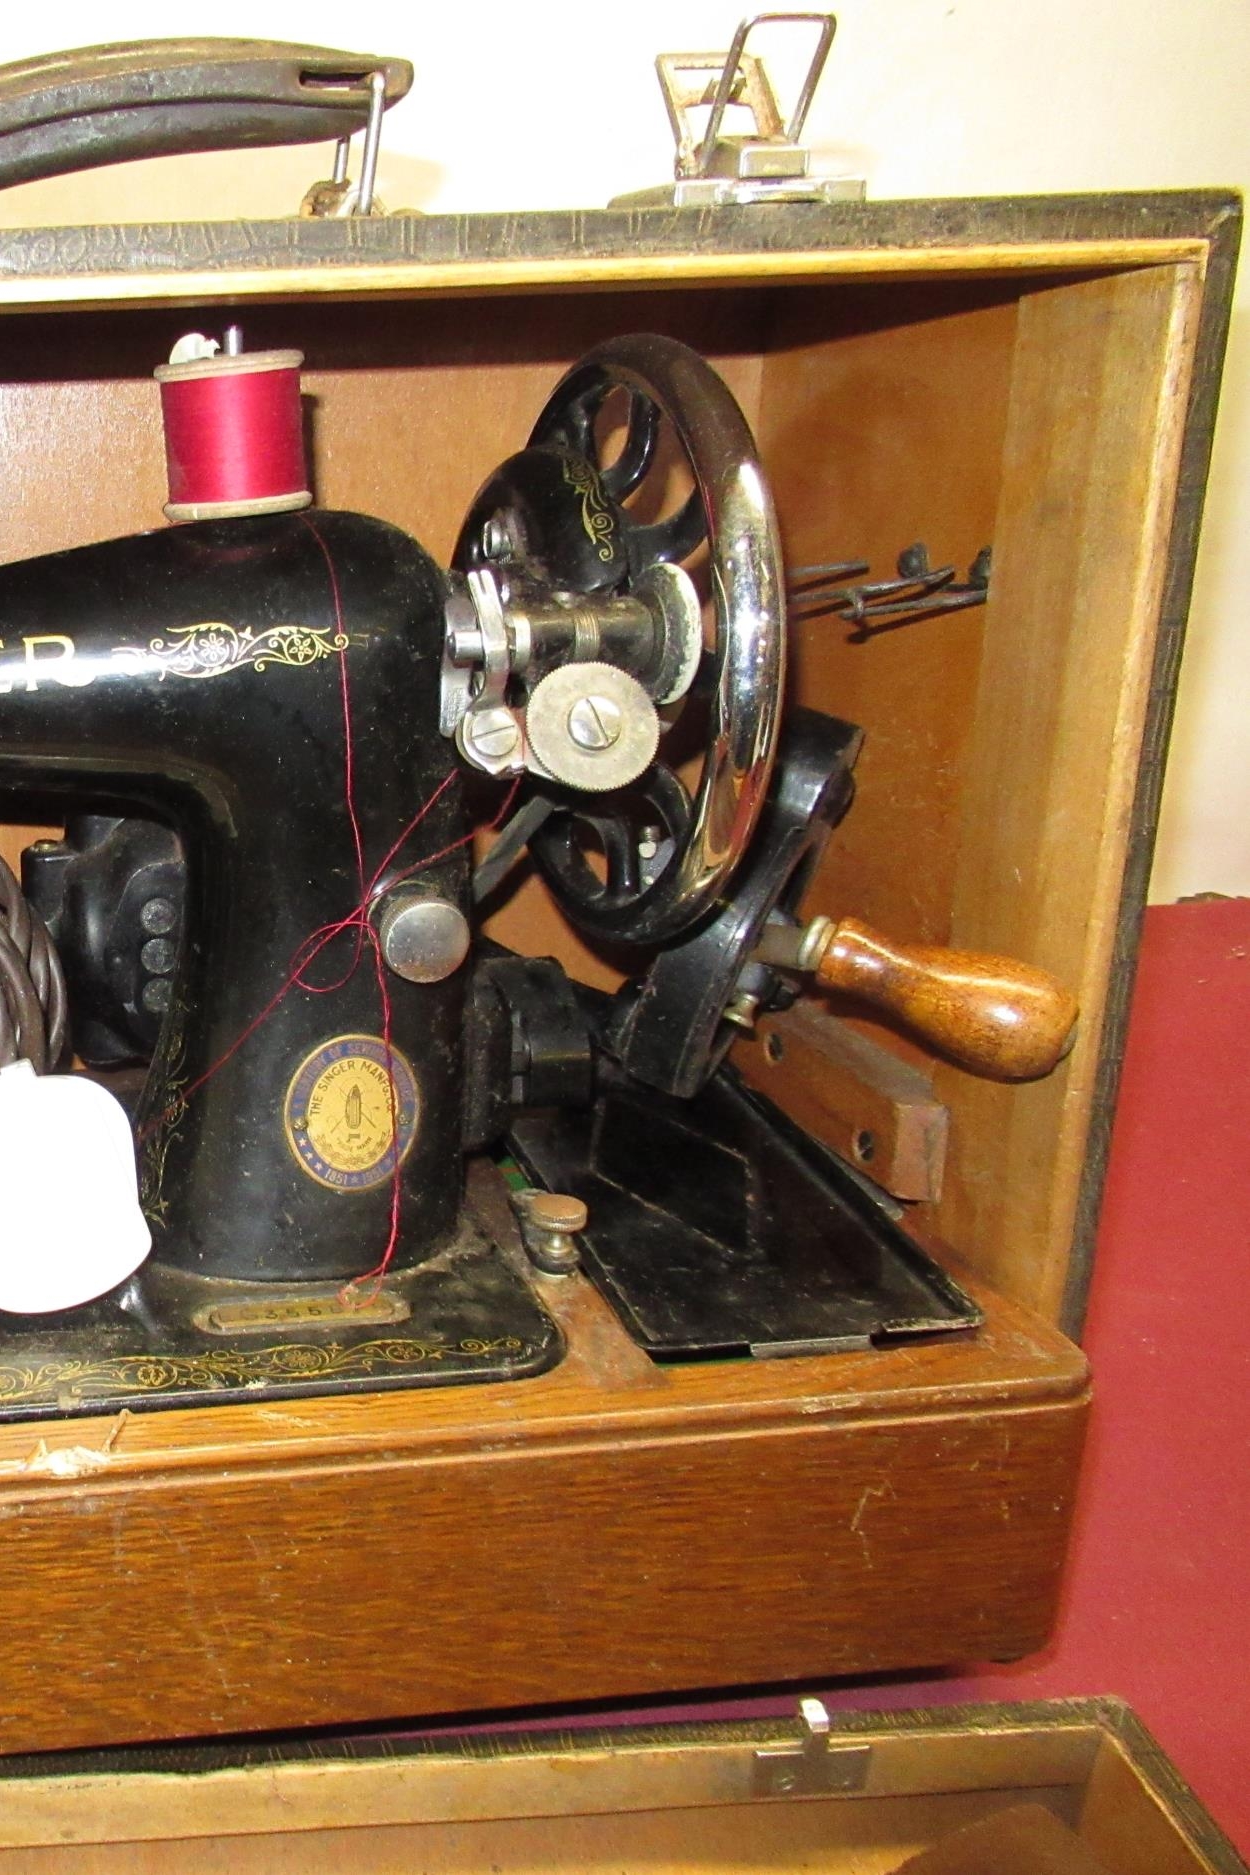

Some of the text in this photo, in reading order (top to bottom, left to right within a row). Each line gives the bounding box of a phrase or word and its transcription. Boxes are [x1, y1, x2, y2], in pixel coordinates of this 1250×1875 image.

[310, 1095, 323, 1116] THE
[318, 1060, 356, 1092] SINGER
[324, 1168, 347, 1185] 1851
